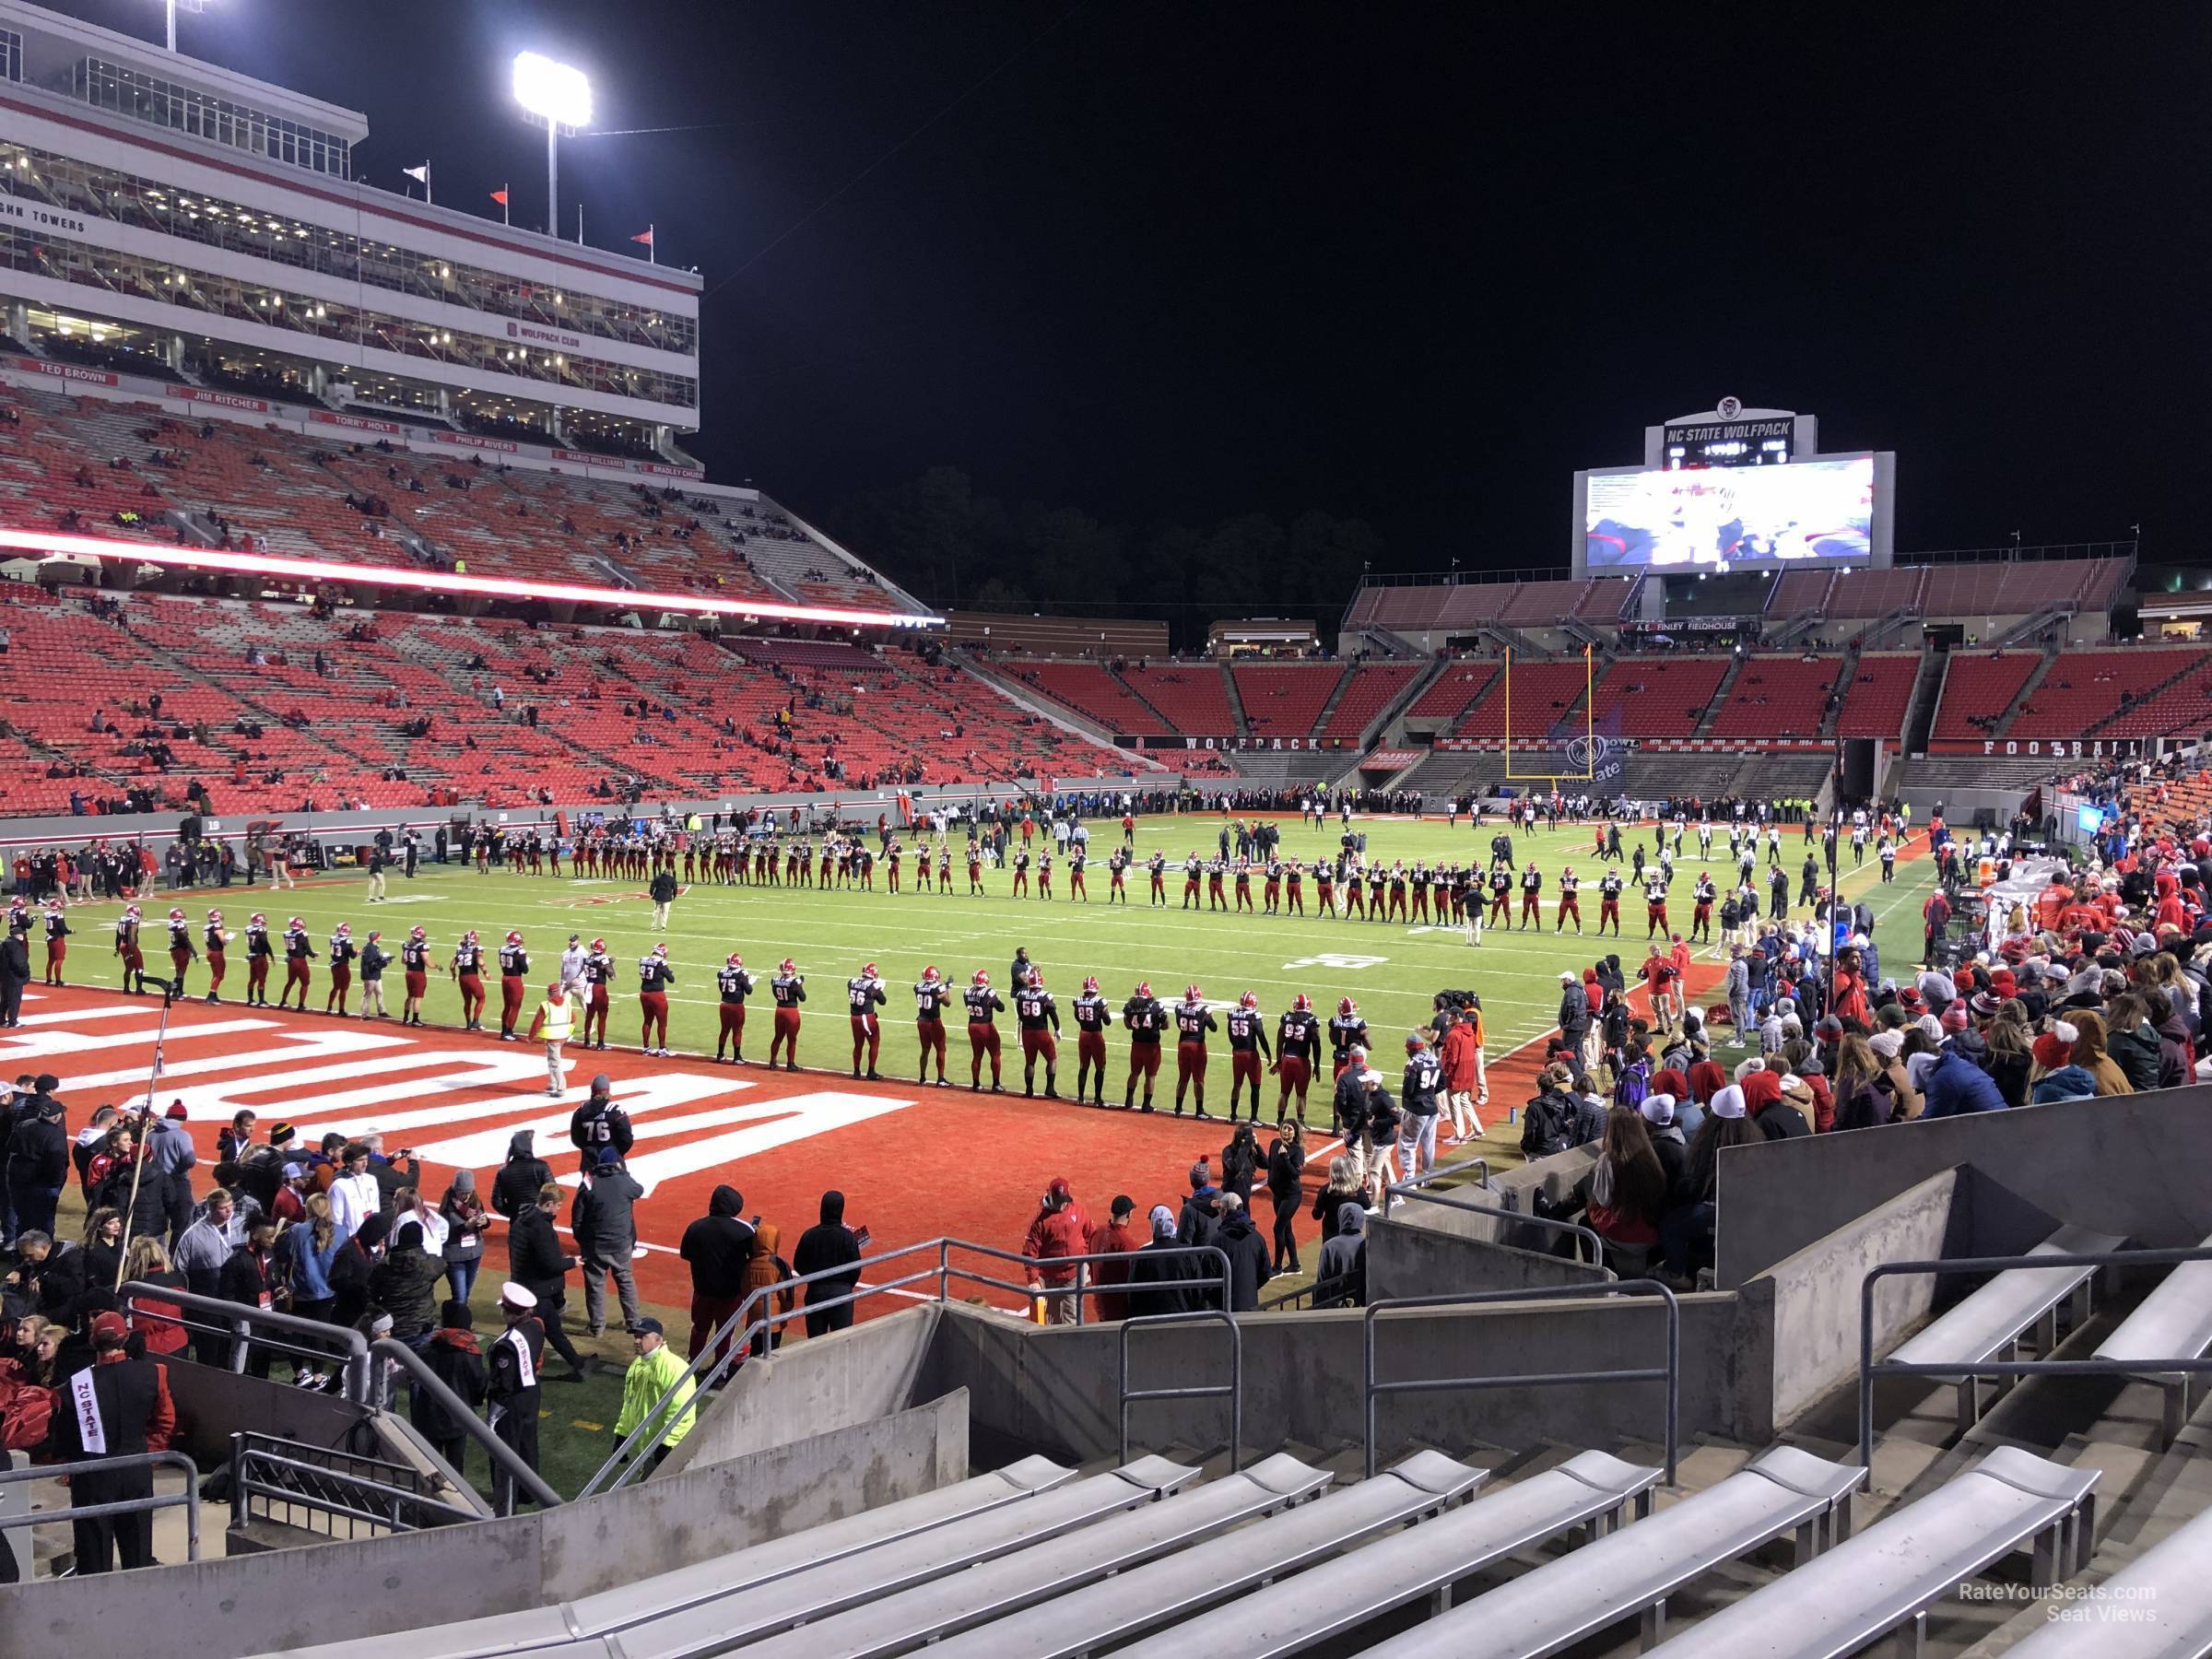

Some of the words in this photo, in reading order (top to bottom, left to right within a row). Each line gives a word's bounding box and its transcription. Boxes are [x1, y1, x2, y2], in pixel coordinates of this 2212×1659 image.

[33, 211, 86, 232] TOWERS
[521, 326, 560, 344] WOLFPACK
[562, 335, 580, 347] CLUB
[39, 363, 62, 375] TED
[65, 368, 107, 382] BROWN
[194, 391, 212, 401] JIM
[215, 395, 259, 410] RITCHER
[335, 416, 365, 428] TORRY
[368, 421, 391, 432] HOLT
[1667, 429, 1684, 442] NC
[1686, 427, 1722, 441] STATE
[1724, 422, 1791, 439] WOLFPACK
[455, 435, 482, 446] PHILIP
[484, 440, 514, 452] RIVERS
[1657, 622, 1684, 631] FINLEY
[1688, 622, 1736, 630] FIELDHOUSE
[1186, 738, 1318, 749] WOLFPACK
[1984, 741, 2136, 756] FOOTBALL
[499, 813, 508, 821] 20
[640, 965, 654, 980] 93
[720, 978, 736, 993] 75
[776, 987, 789, 1001] 91
[849, 989, 866, 1006] 56
[917, 994, 933, 1009] 90
[1022, 1001, 1041, 1017] 58
[1131, 1014, 1152, 1030] 44
[1230, 1019, 1249, 1037] 55
[1285, 1025, 1306, 1041] 92
[1340, 1030, 1347, 1045] 1
[1420, 1069, 1441, 1088] 94
[582, 1121, 611, 1142] 76
[77, 1382, 90, 1399] NC
[81, 1400, 99, 1438] STATE
